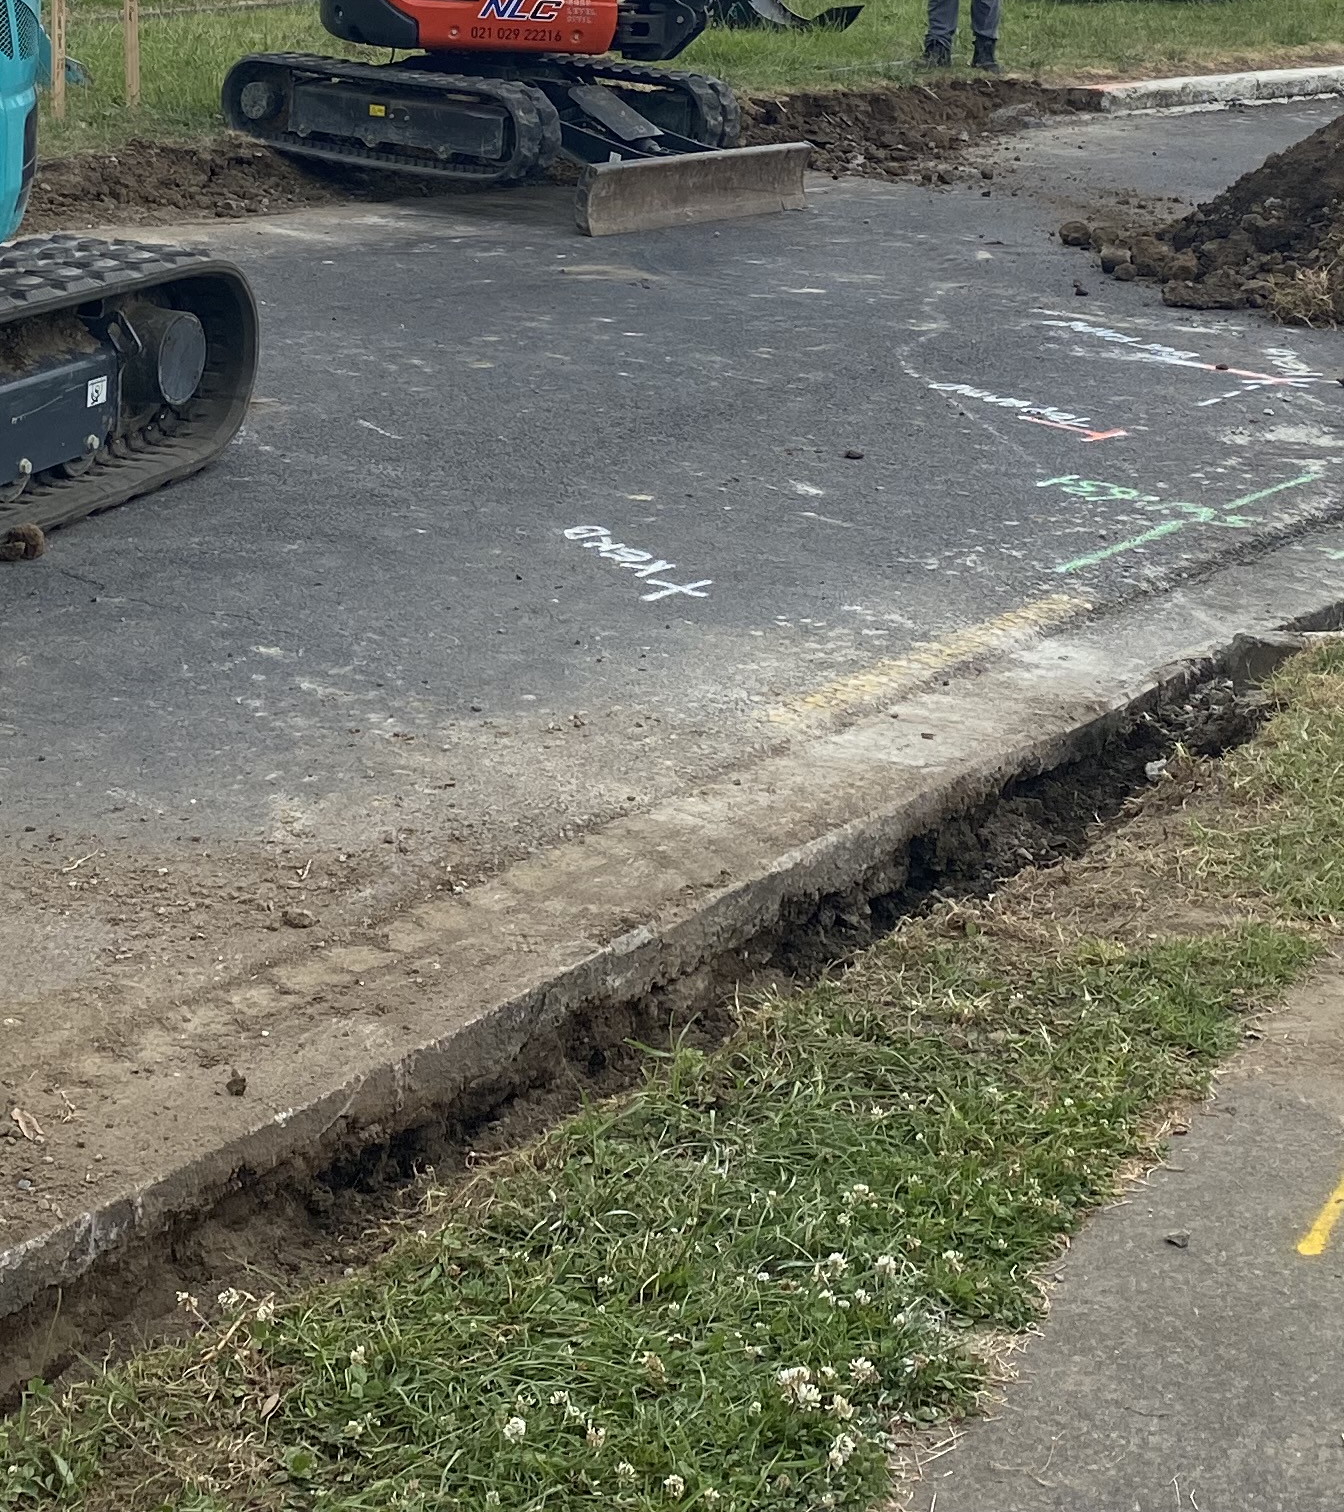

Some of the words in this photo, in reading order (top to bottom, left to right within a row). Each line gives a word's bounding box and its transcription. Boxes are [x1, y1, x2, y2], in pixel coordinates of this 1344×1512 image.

[471, 26, 492, 39] 021
[497, 28, 520, 40] 029
[524, 29, 562, 42] 22216
